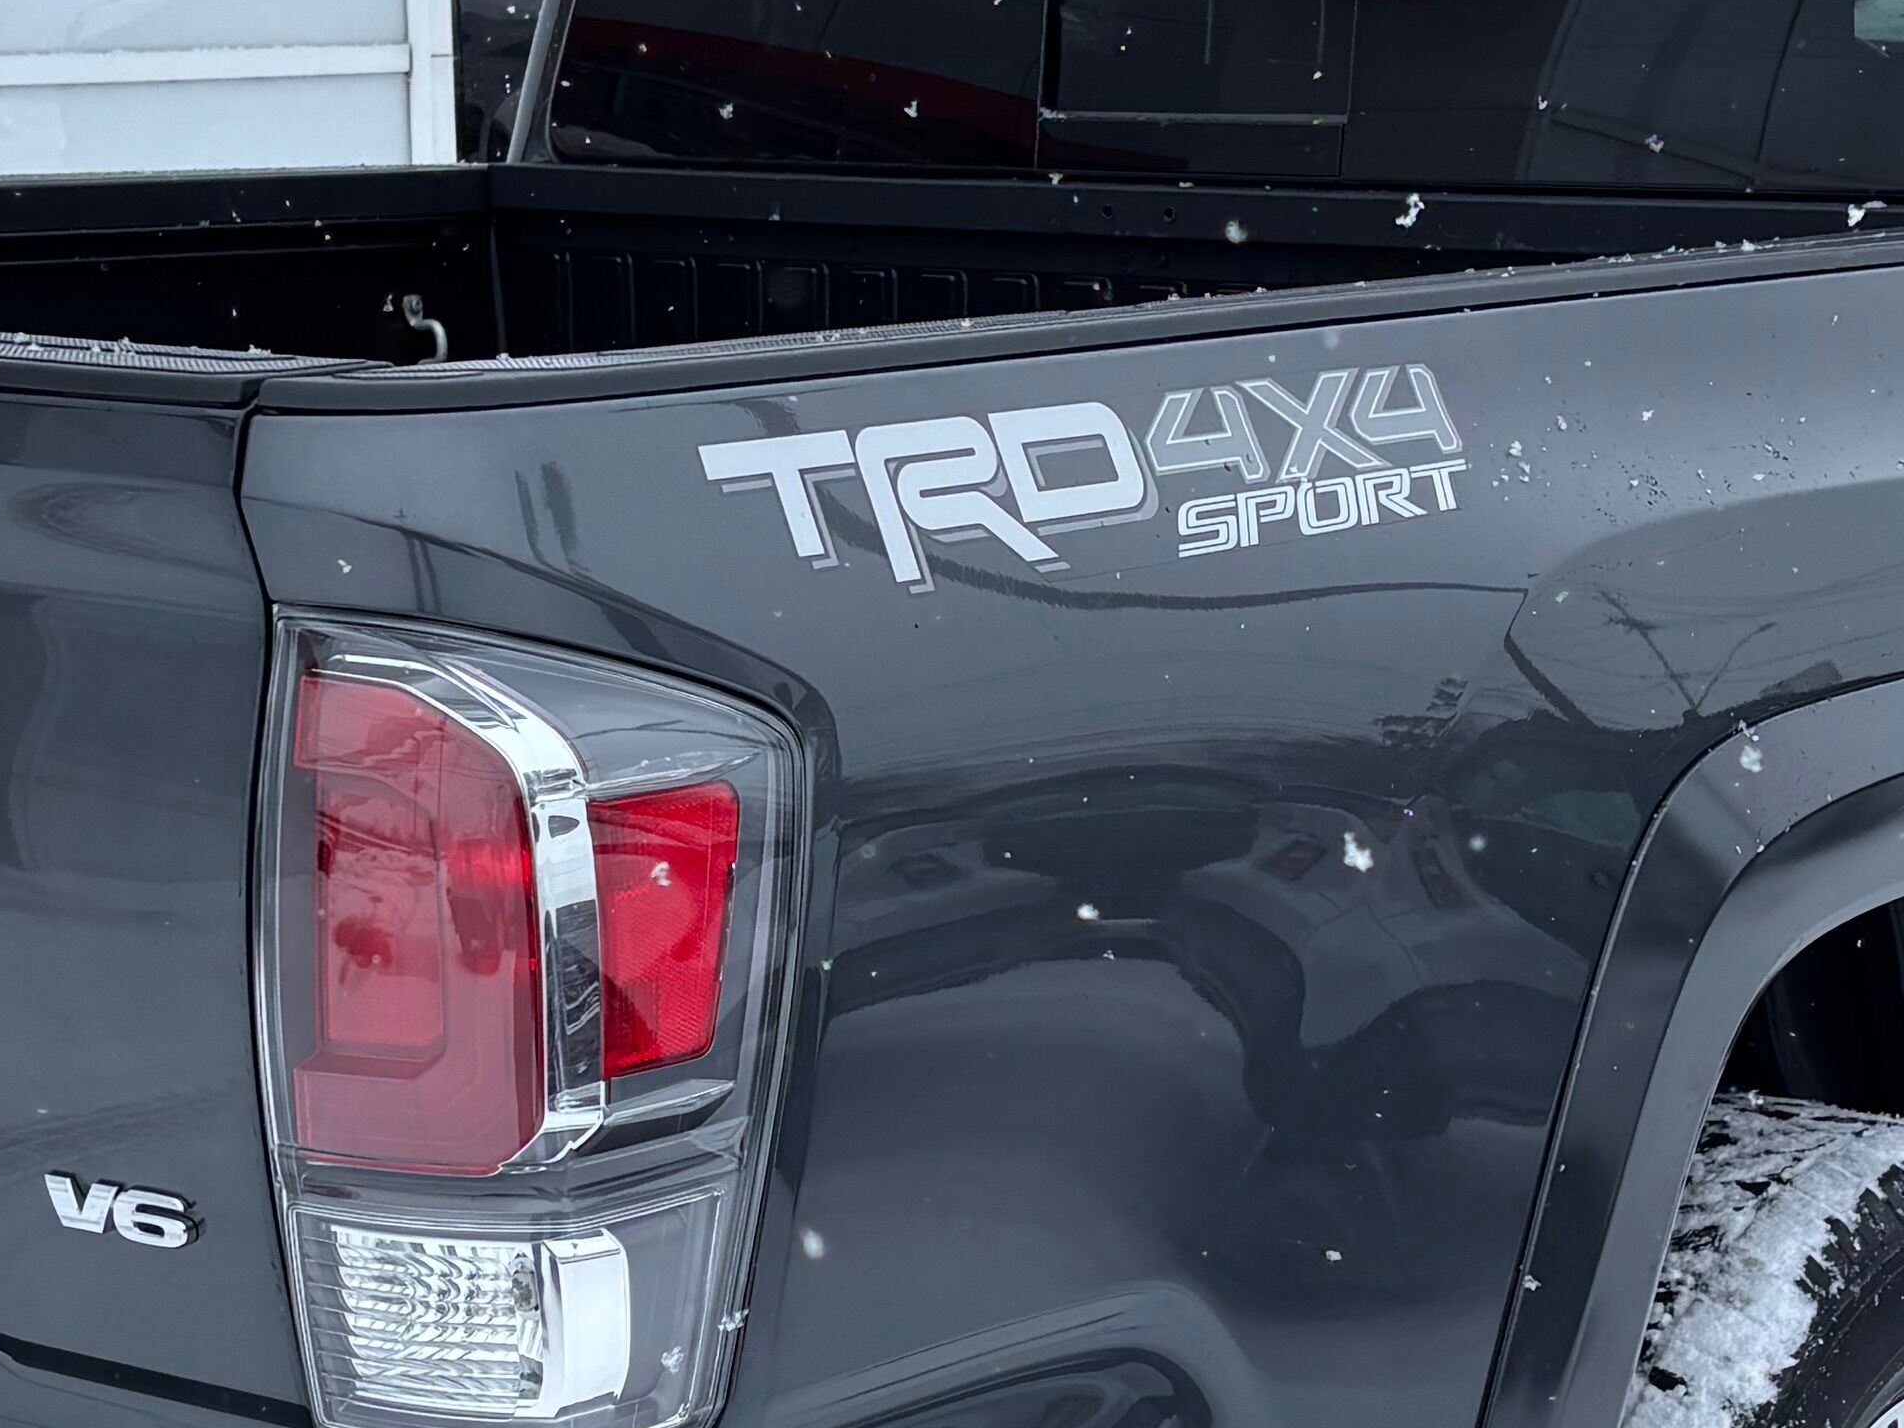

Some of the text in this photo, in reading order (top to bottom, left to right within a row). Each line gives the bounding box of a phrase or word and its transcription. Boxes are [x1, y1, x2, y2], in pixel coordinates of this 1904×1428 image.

[697, 364, 1463, 594] TRD 4X4
[1177, 458, 1469, 559] SPORT
[44, 1171, 196, 1249] V6
